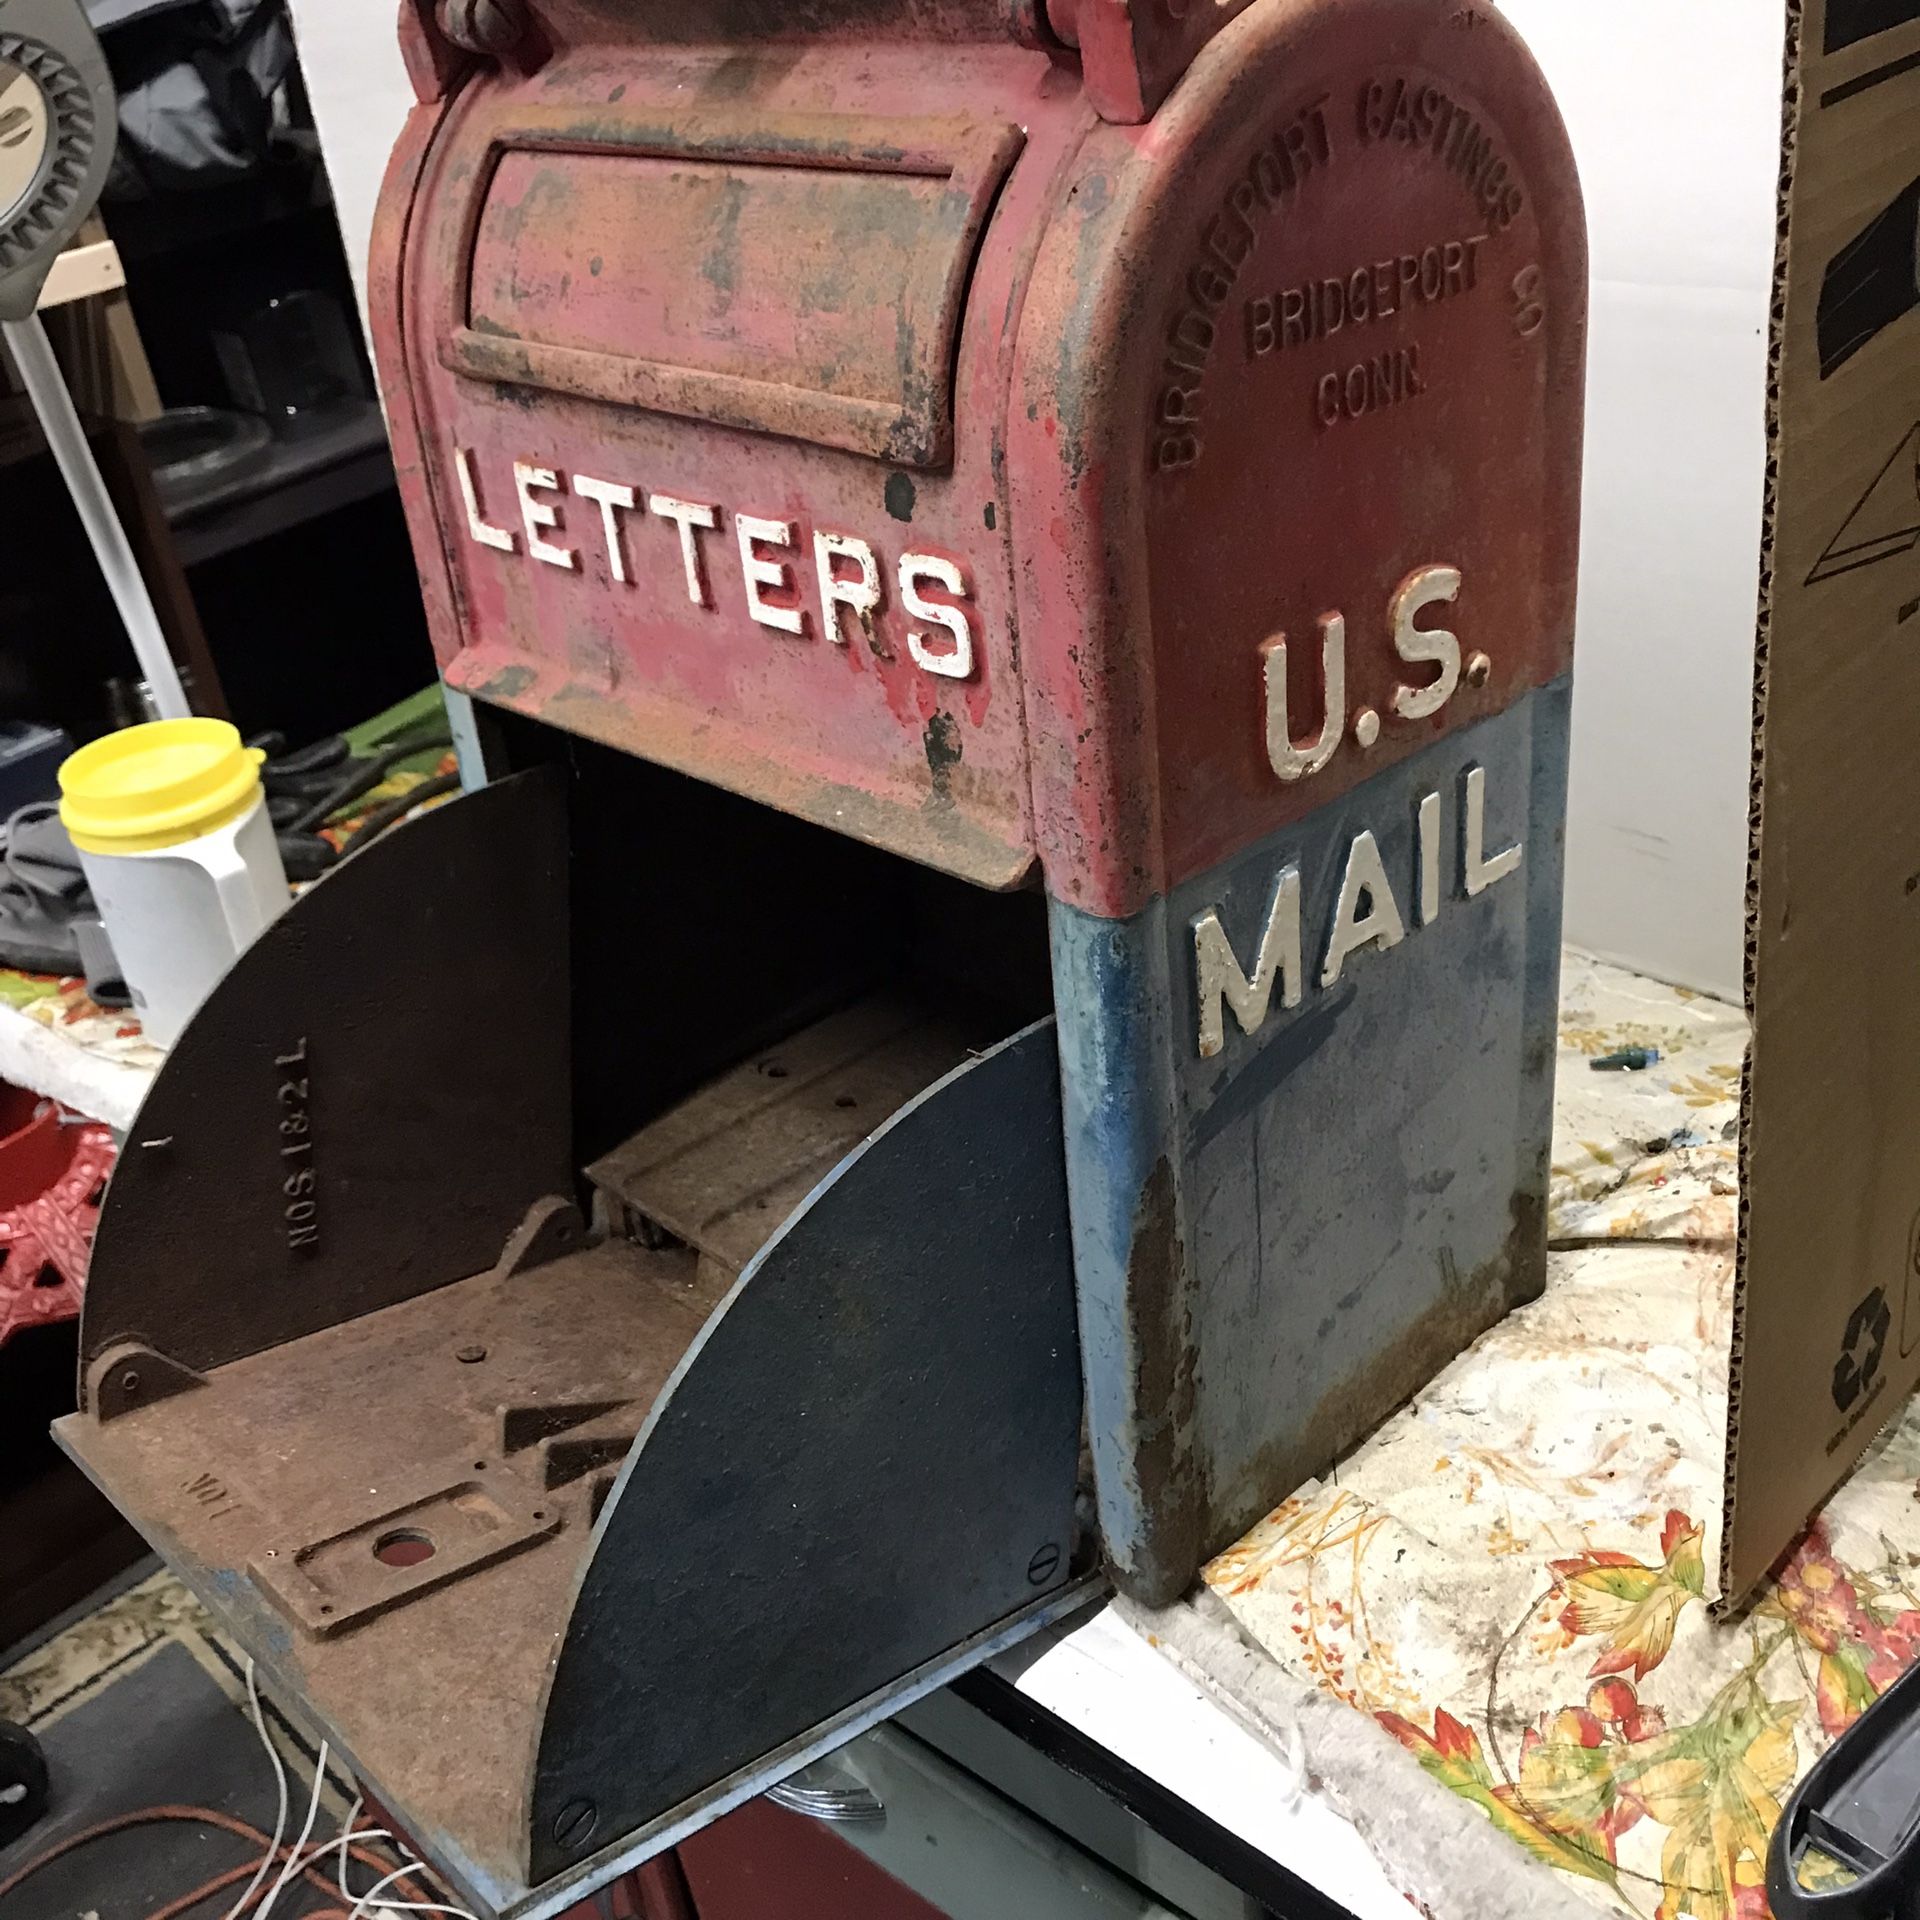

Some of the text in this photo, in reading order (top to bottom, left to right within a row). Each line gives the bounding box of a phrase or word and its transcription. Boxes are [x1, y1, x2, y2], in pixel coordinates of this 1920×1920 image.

[1155, 92, 1332, 472] BRIDGEPORT
[1356, 78, 1523, 232] CASTINGS
[1246, 234, 1488, 358] BRIDGEPORT
[455, 446, 978, 679] LETTERS
[1260, 565, 1491, 780] U.S.
[1192, 765, 1522, 1057] MAIL
